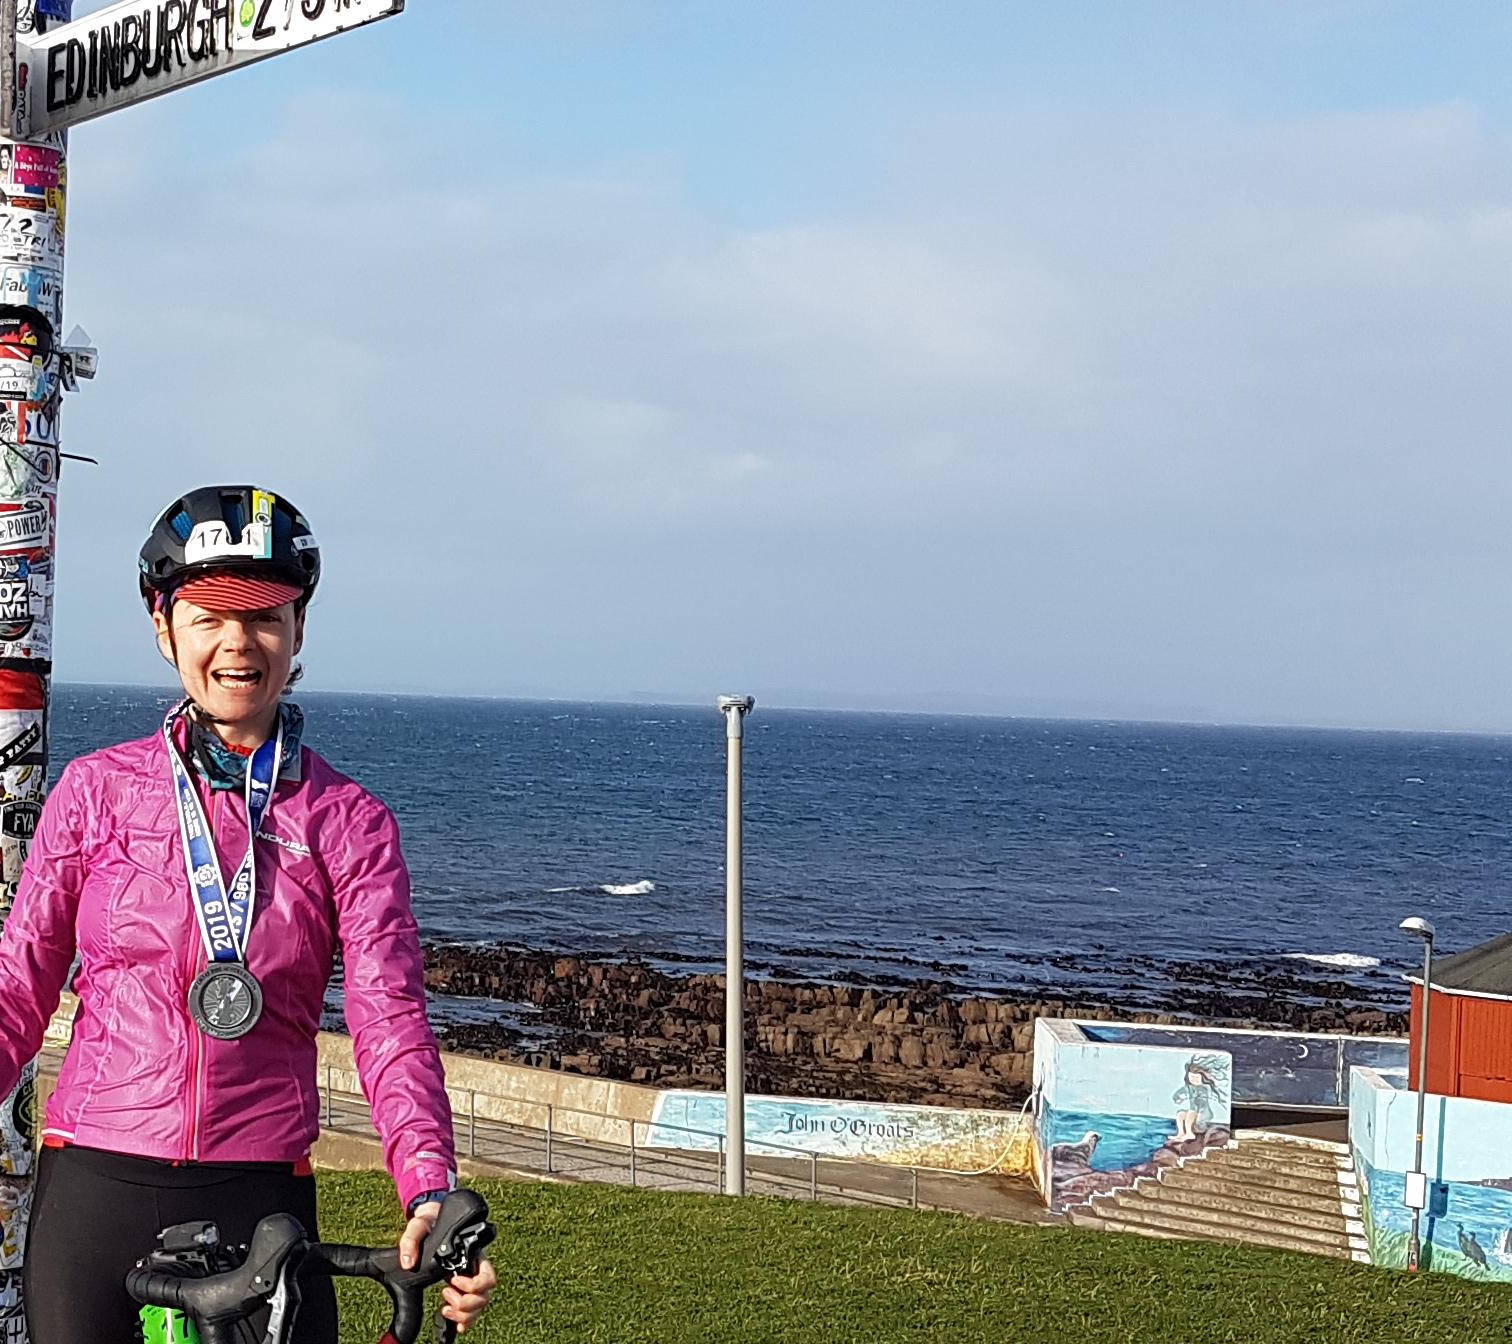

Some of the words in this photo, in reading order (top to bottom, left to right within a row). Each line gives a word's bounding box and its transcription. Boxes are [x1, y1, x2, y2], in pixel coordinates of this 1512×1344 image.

[7, 515, 41, 539] POWER
[197, 528, 252, 548] 171
[14, 813, 34, 833] FYA
[255, 830, 311, 853] NDURA
[232, 872, 249, 900] 980
[204, 901, 234, 952] 2019
[774, 1111, 825, 1135] John
[830, 1116, 915, 1138] O'Groats
